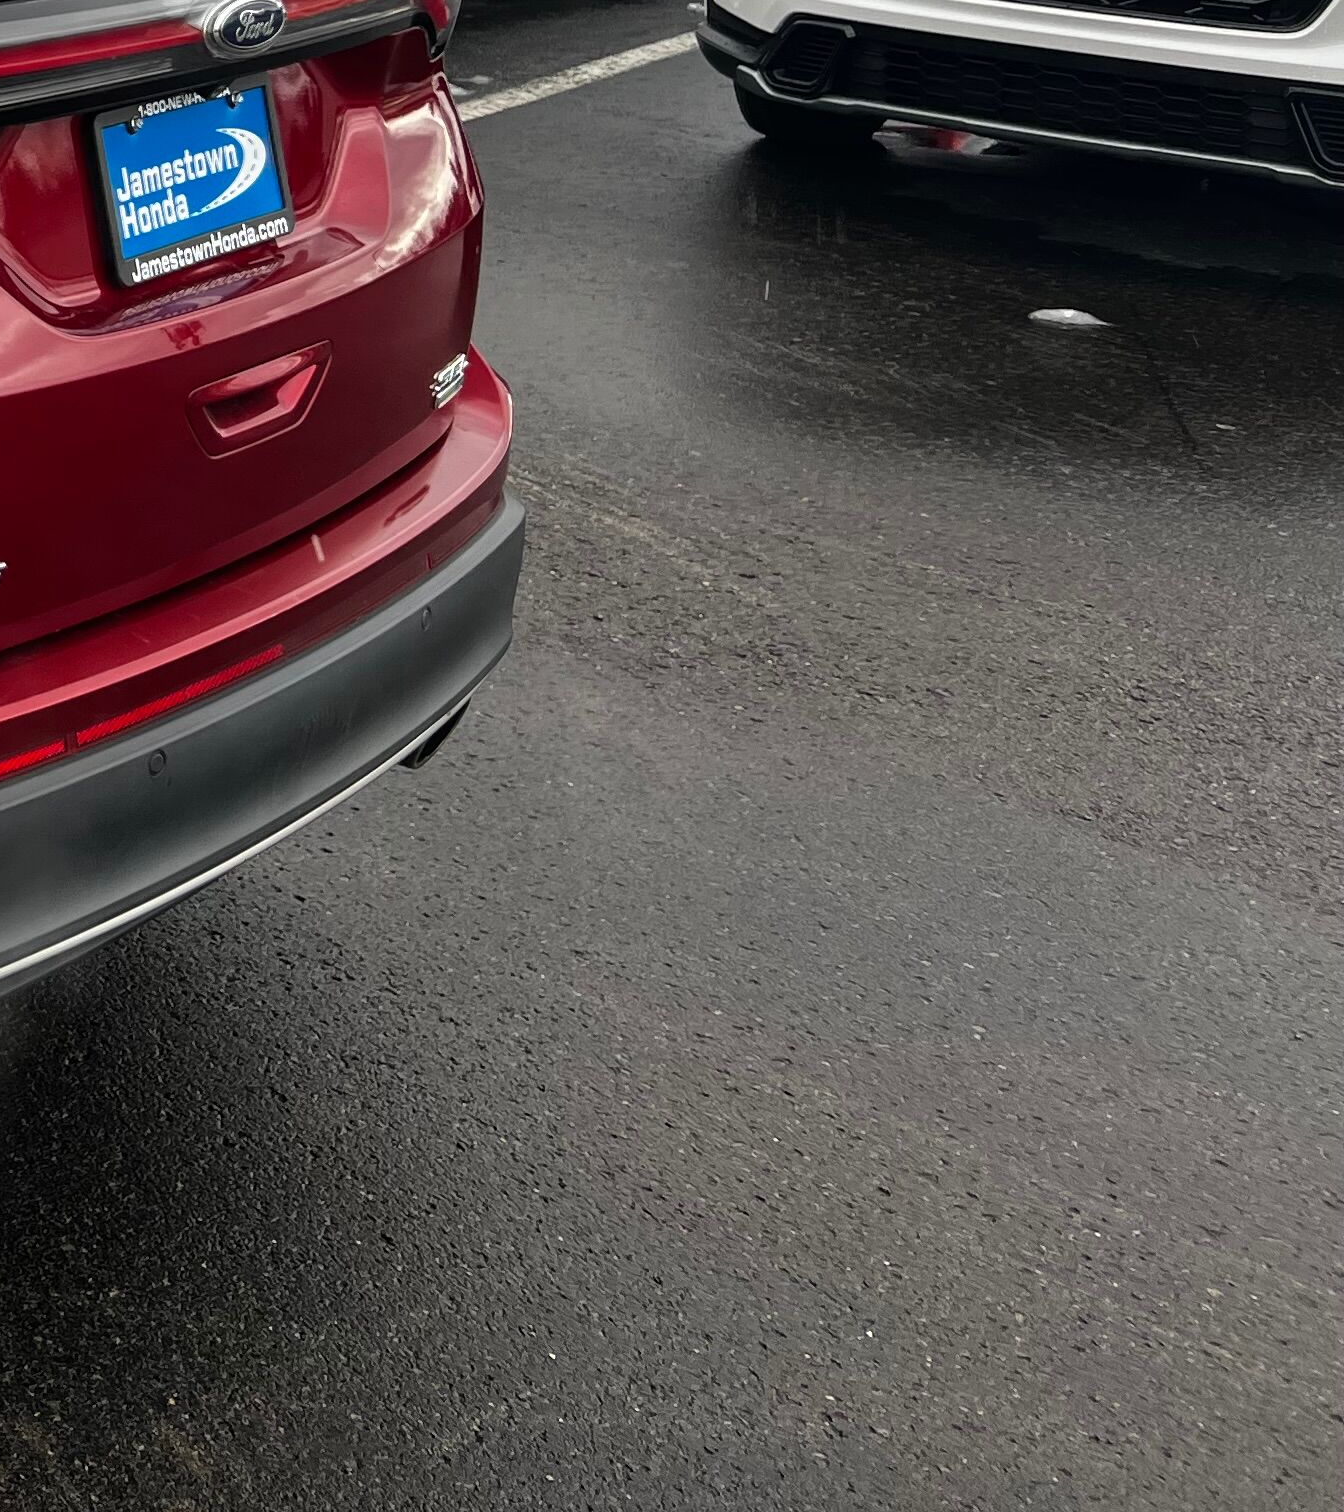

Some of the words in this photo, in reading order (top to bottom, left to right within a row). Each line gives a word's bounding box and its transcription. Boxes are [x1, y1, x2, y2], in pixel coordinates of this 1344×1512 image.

[236, 9, 280, 42] Ford
[138, 87, 231, 118] 1-800-NEW-HA
[117, 143, 239, 203] Jamestown
[118, 188, 190, 239] Honda
[132, 216, 290, 283] JamestownHonda.com
